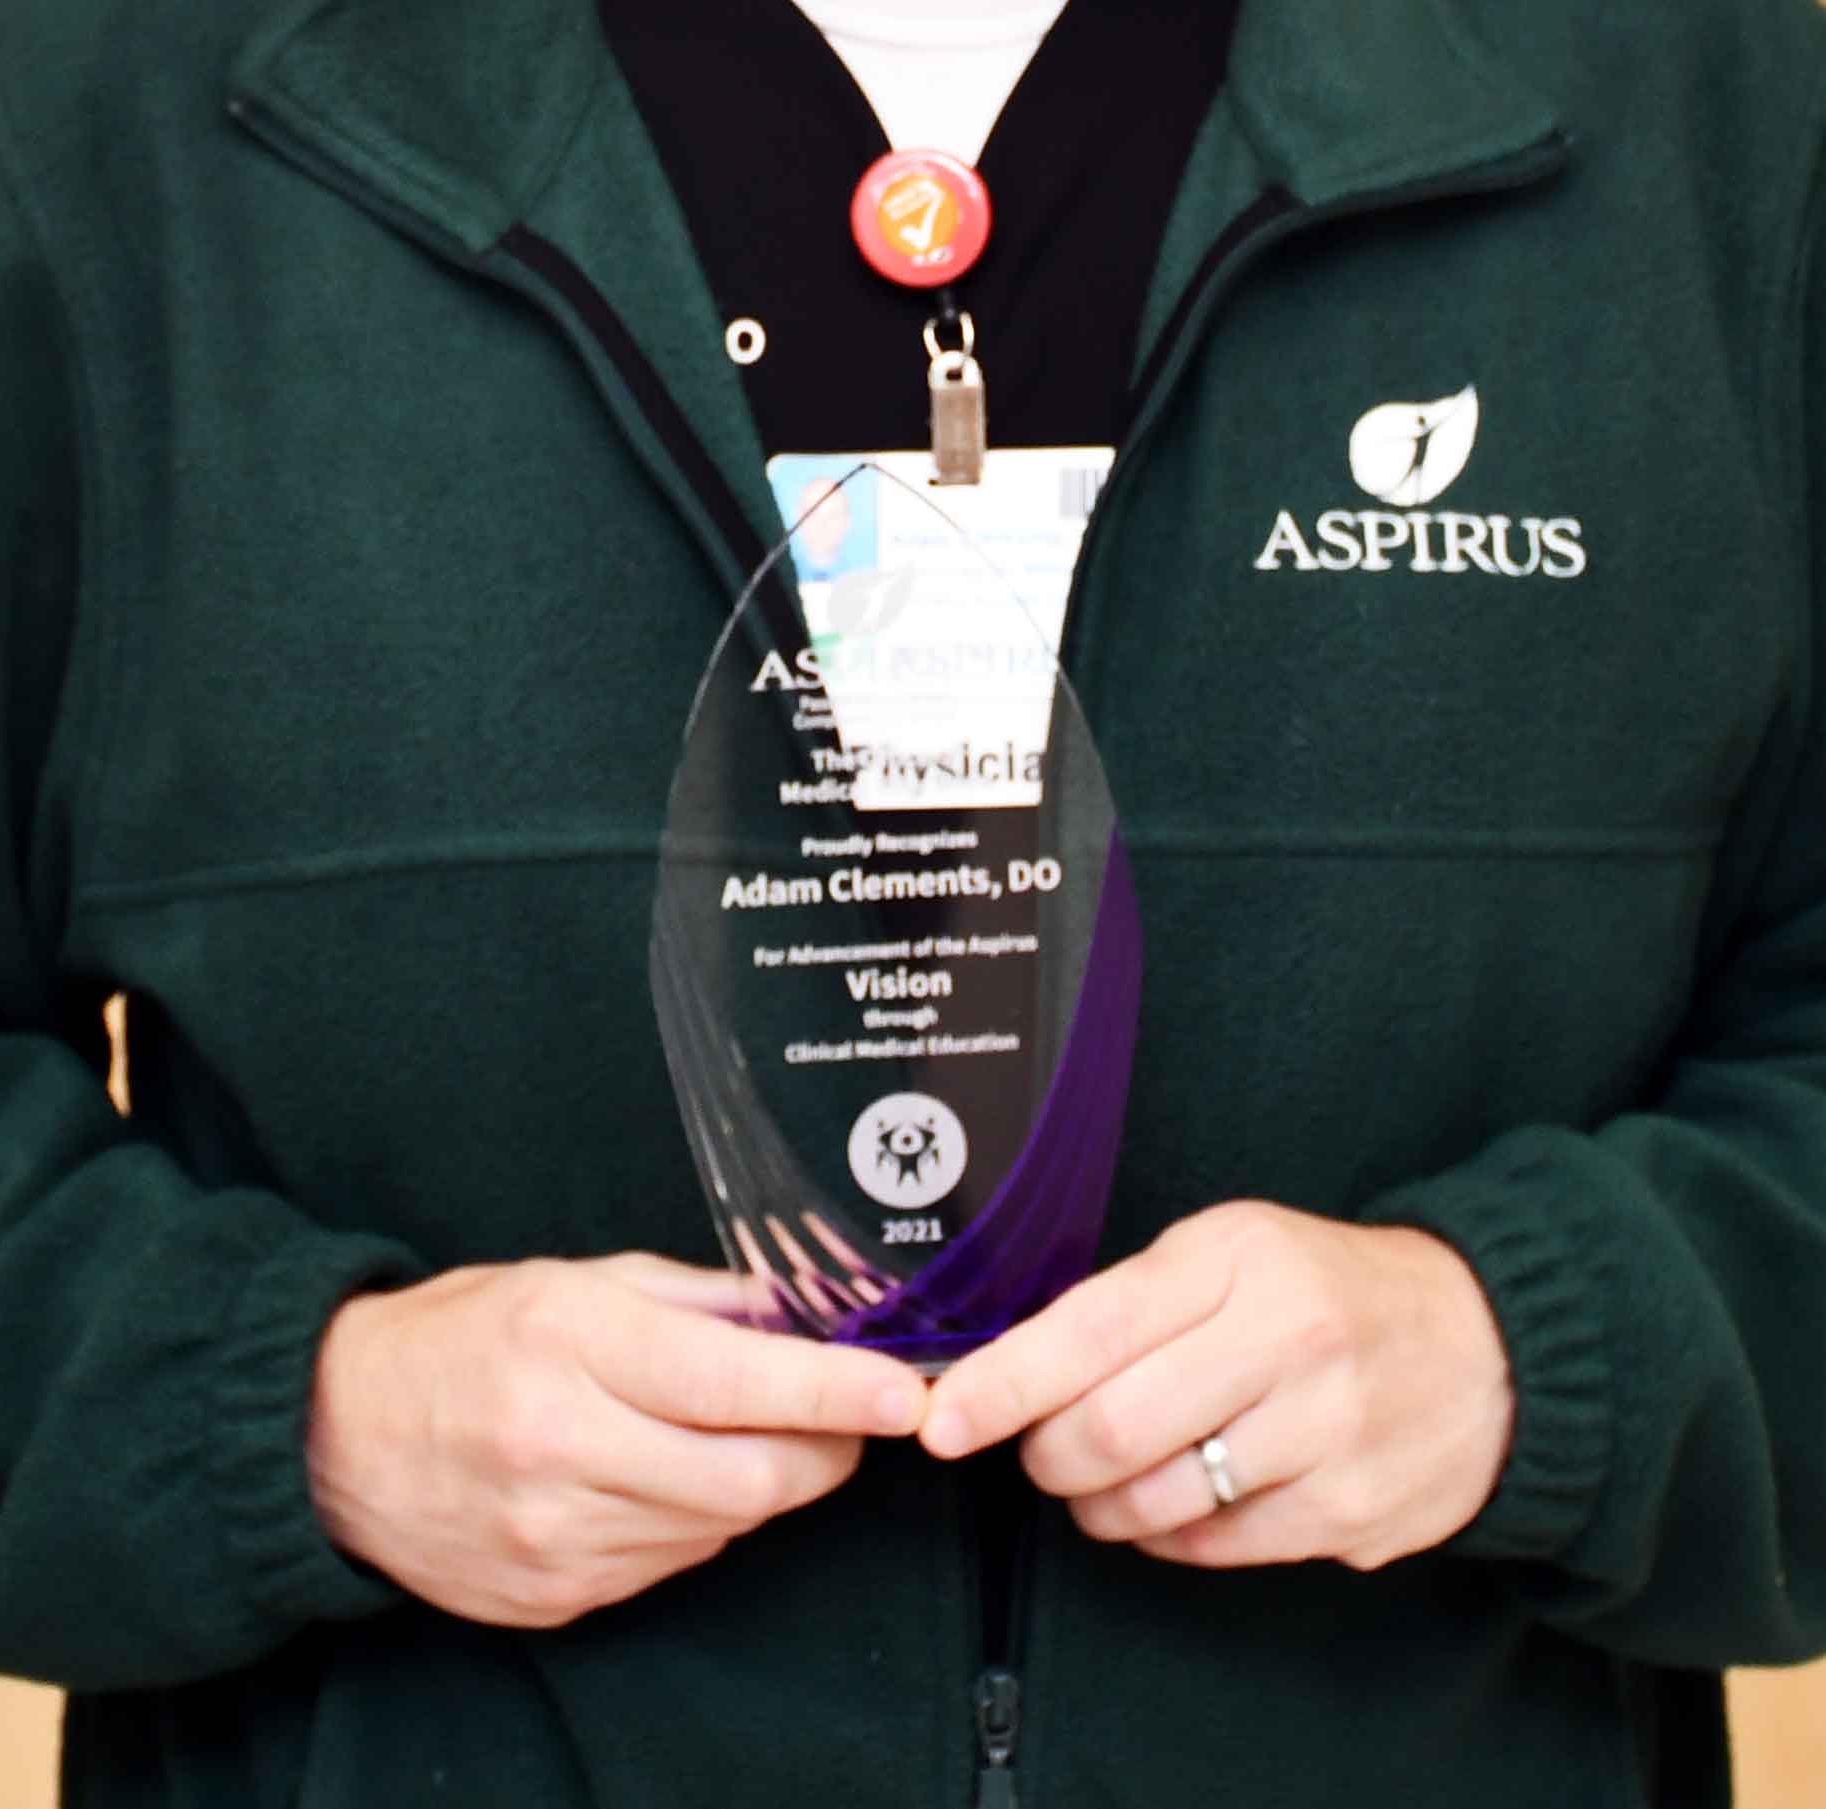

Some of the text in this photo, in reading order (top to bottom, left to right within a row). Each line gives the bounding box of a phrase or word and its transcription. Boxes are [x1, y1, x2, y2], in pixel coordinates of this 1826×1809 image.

[1254, 510, 1587, 578] ASPIRUS
[849, 741, 1044, 793] Physicia
[801, 833, 873, 858] Proudly
[721, 856, 1062, 909] Adam Clements, DO
[913, 936, 934, 957] of
[935, 936, 966, 956] the
[845, 964, 953, 1002] Vision
[784, 1040, 853, 1064] Clinical
[927, 1032, 1021, 1056] Education
[881, 1218, 944, 1245] 2021
